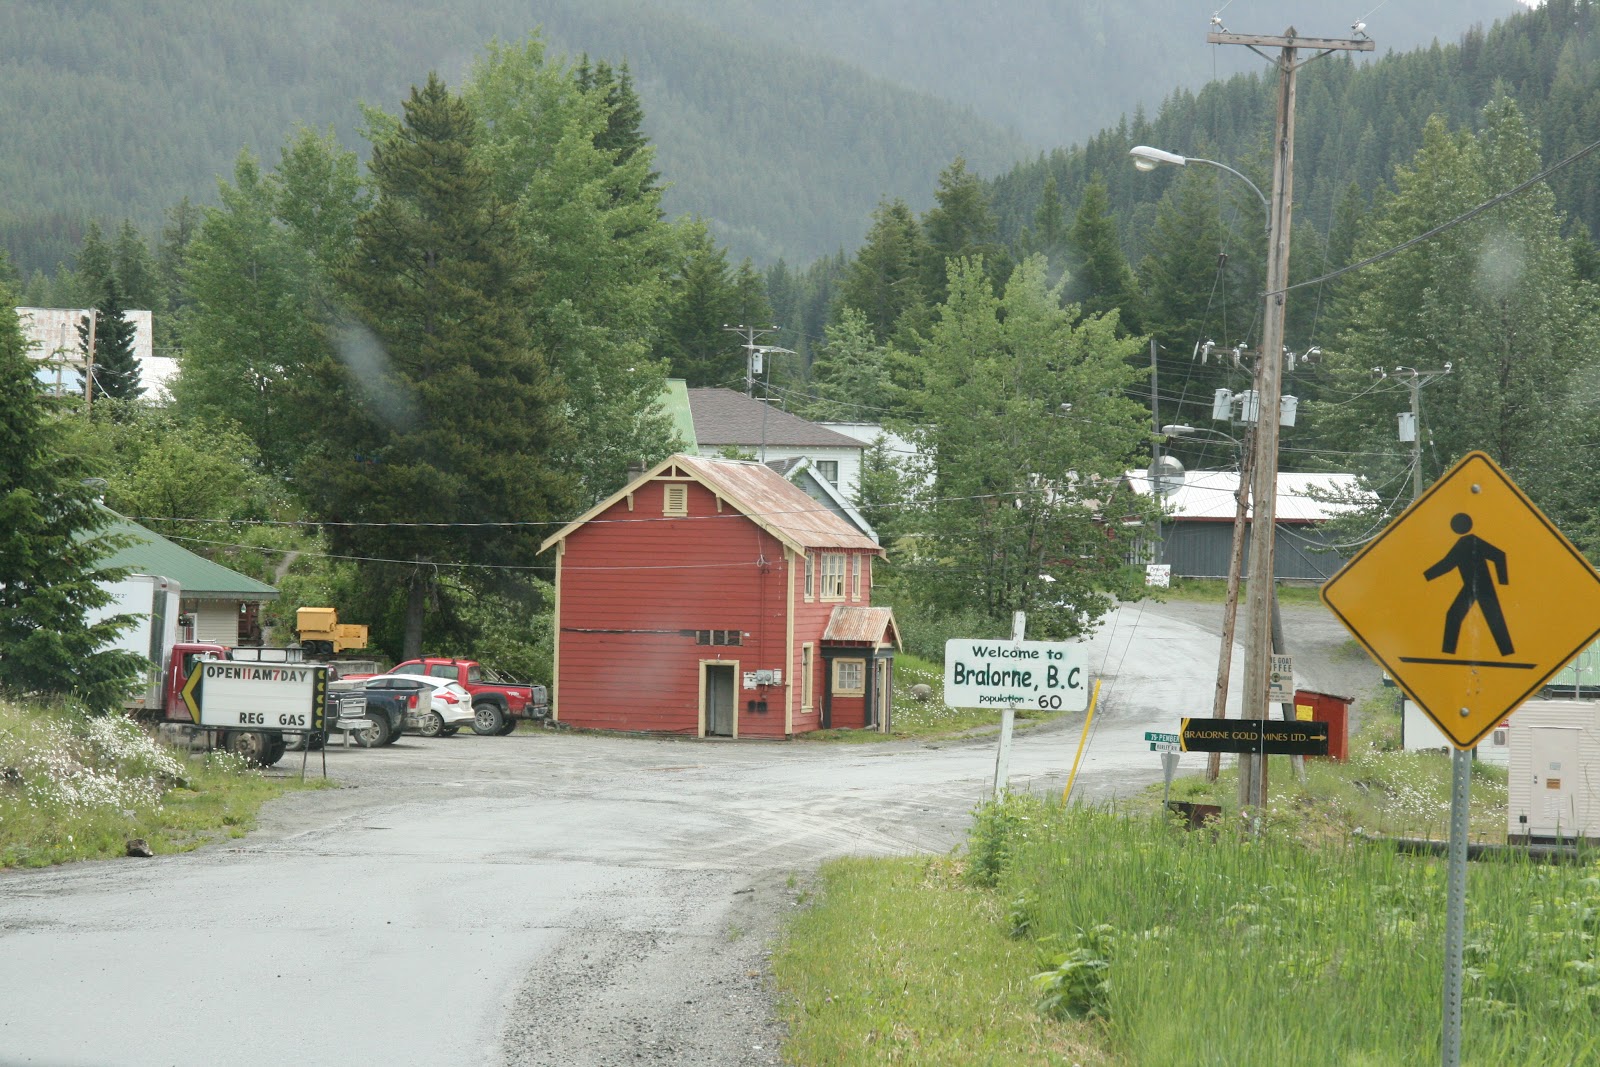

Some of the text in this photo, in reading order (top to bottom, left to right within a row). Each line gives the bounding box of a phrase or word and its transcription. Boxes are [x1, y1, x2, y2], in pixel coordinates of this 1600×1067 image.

[972, 646, 1062, 660] Welcome to
[954, 662, 1084, 691] Bralorne, B.C.
[979, 694, 1024, 704] population
[1038, 695, 1062, 709] 60
[239, 712, 306, 726] REG GAS
[1159, 734, 1180, 743] PEMBER
[1184, 730, 1309, 742] BRALORNE GOLD MINES LTD.
